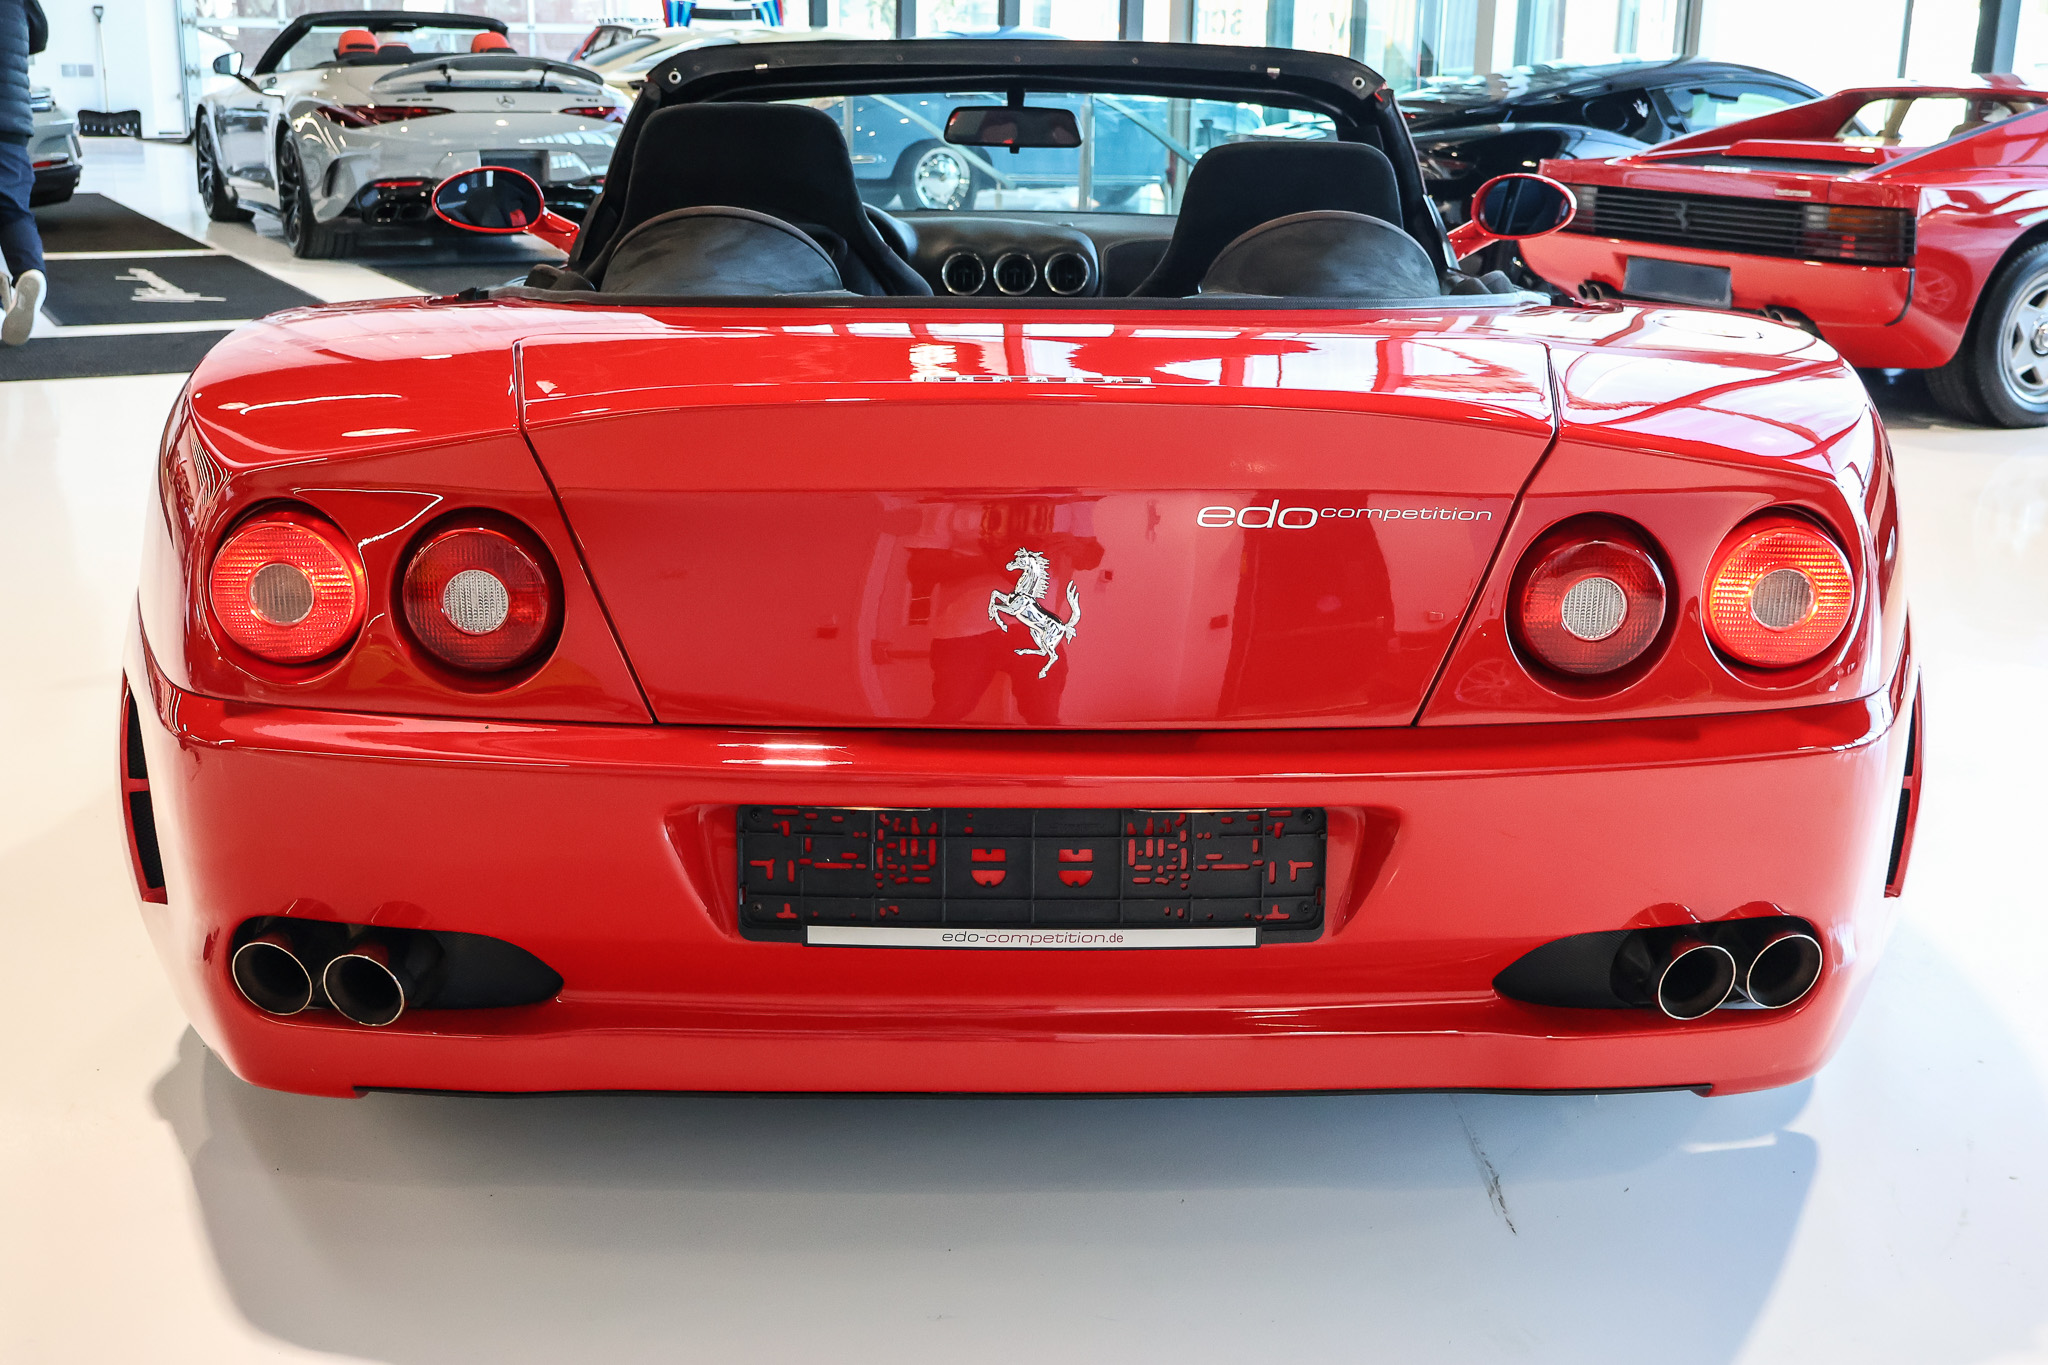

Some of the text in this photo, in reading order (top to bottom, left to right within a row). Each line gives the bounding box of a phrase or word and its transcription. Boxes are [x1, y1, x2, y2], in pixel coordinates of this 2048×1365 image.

[1196, 499, 1492, 530] edo competition
[942, 931, 1124, 946] edo-competition.de
